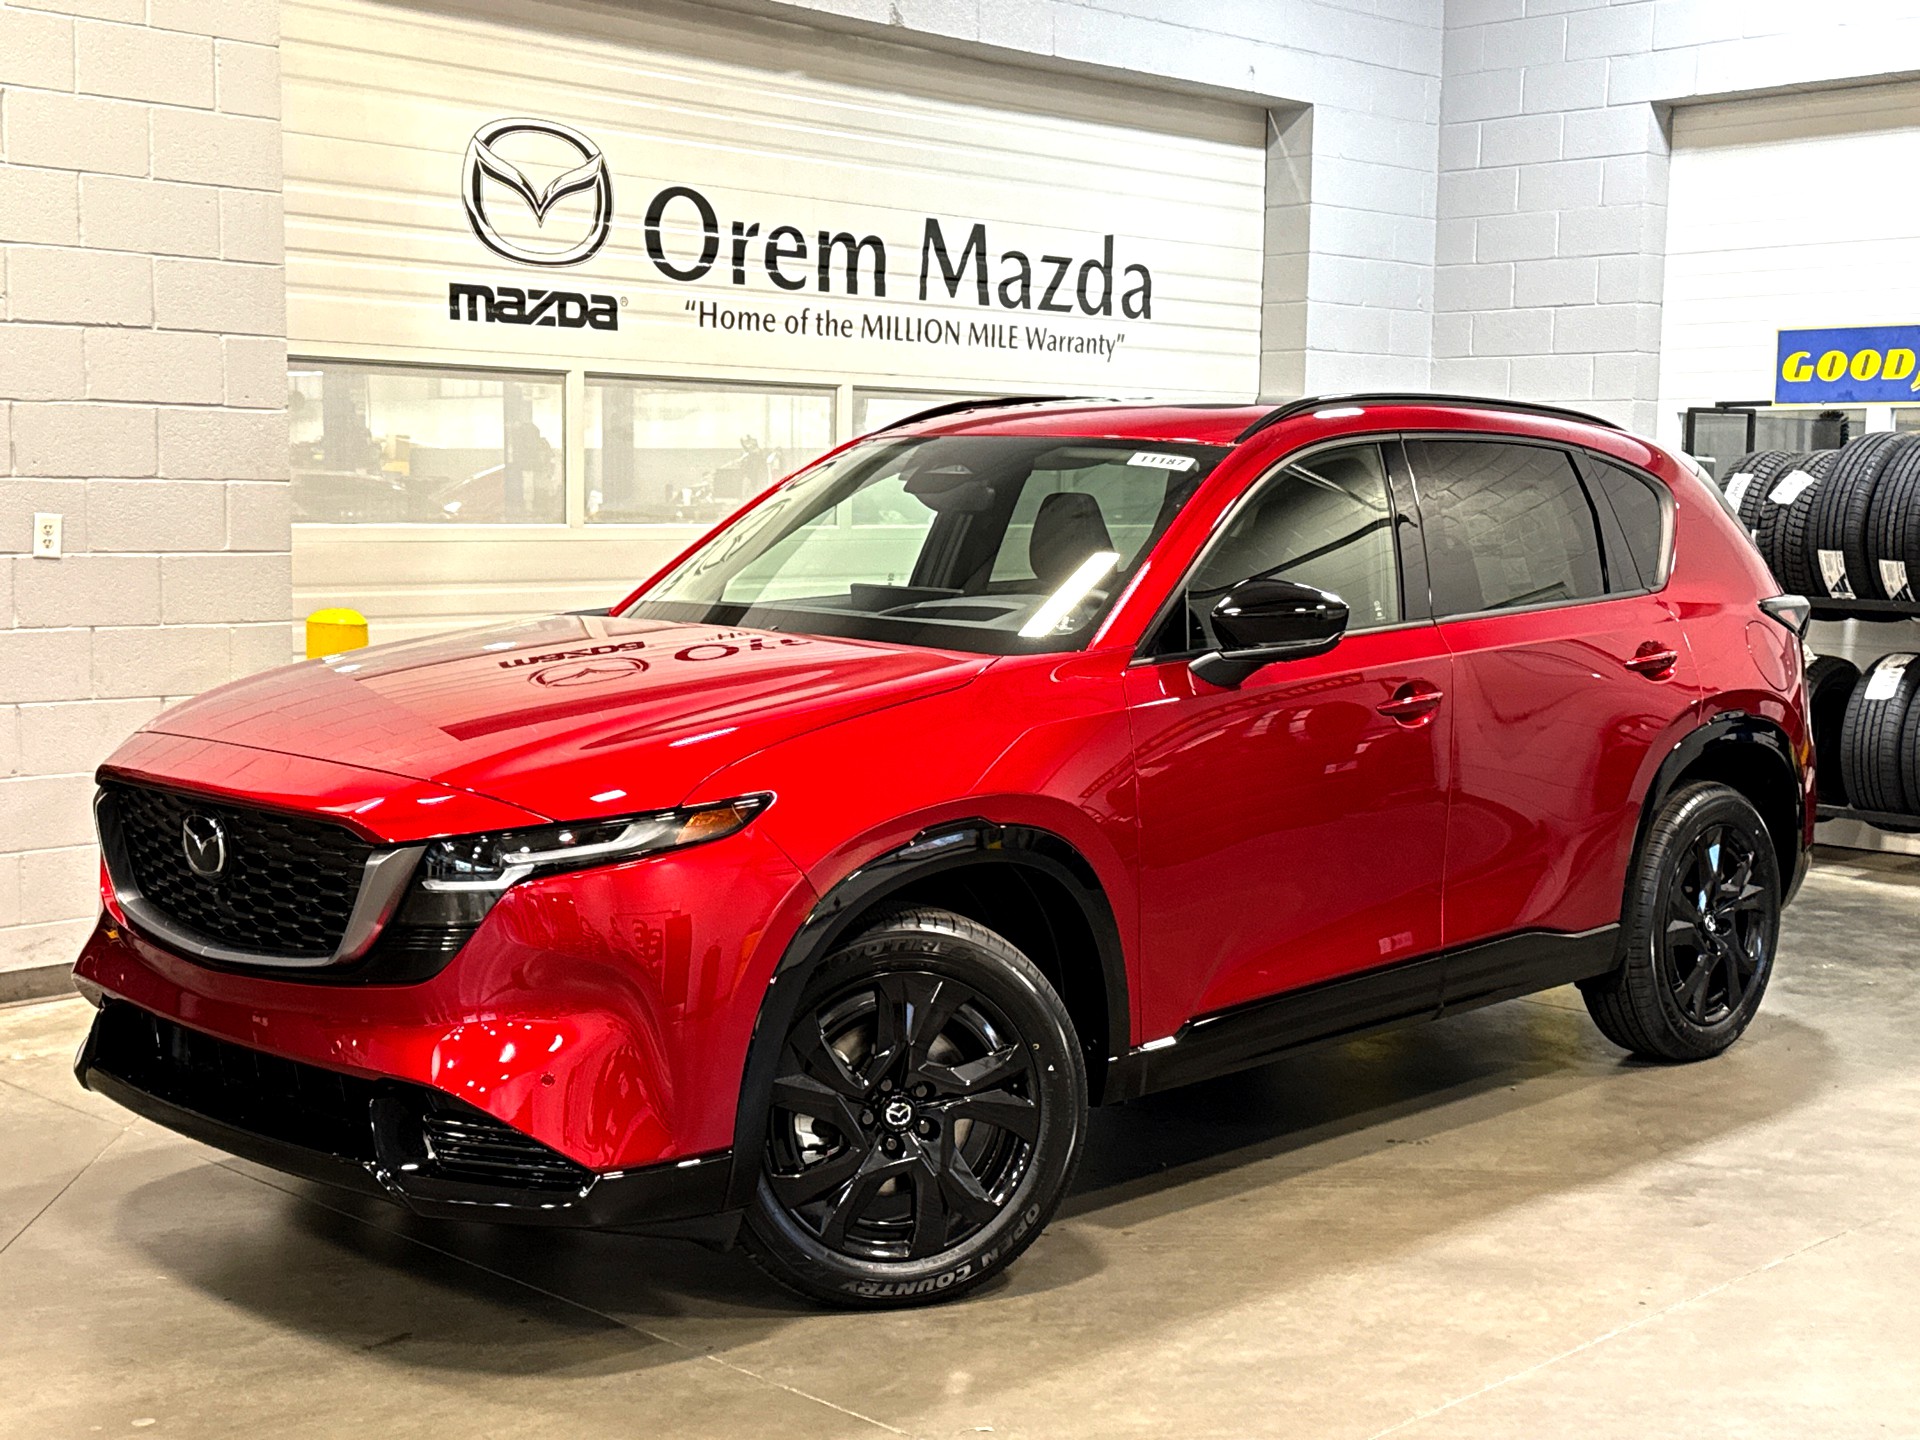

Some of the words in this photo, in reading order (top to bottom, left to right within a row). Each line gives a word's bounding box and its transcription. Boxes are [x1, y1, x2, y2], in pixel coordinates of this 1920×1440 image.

[644, 186, 886, 297] Orem
[918, 217, 1152, 320] Mazda
[784, 307, 811, 335] of
[815, 309, 853, 338] the
[860, 313, 961, 346] MILLION
[968, 322, 1019, 350] MILE
[1140, 455, 1187, 466] 11187
[981, 1202, 1041, 1267] OPEN
[840, 1263, 972, 1297] COUNTRY
